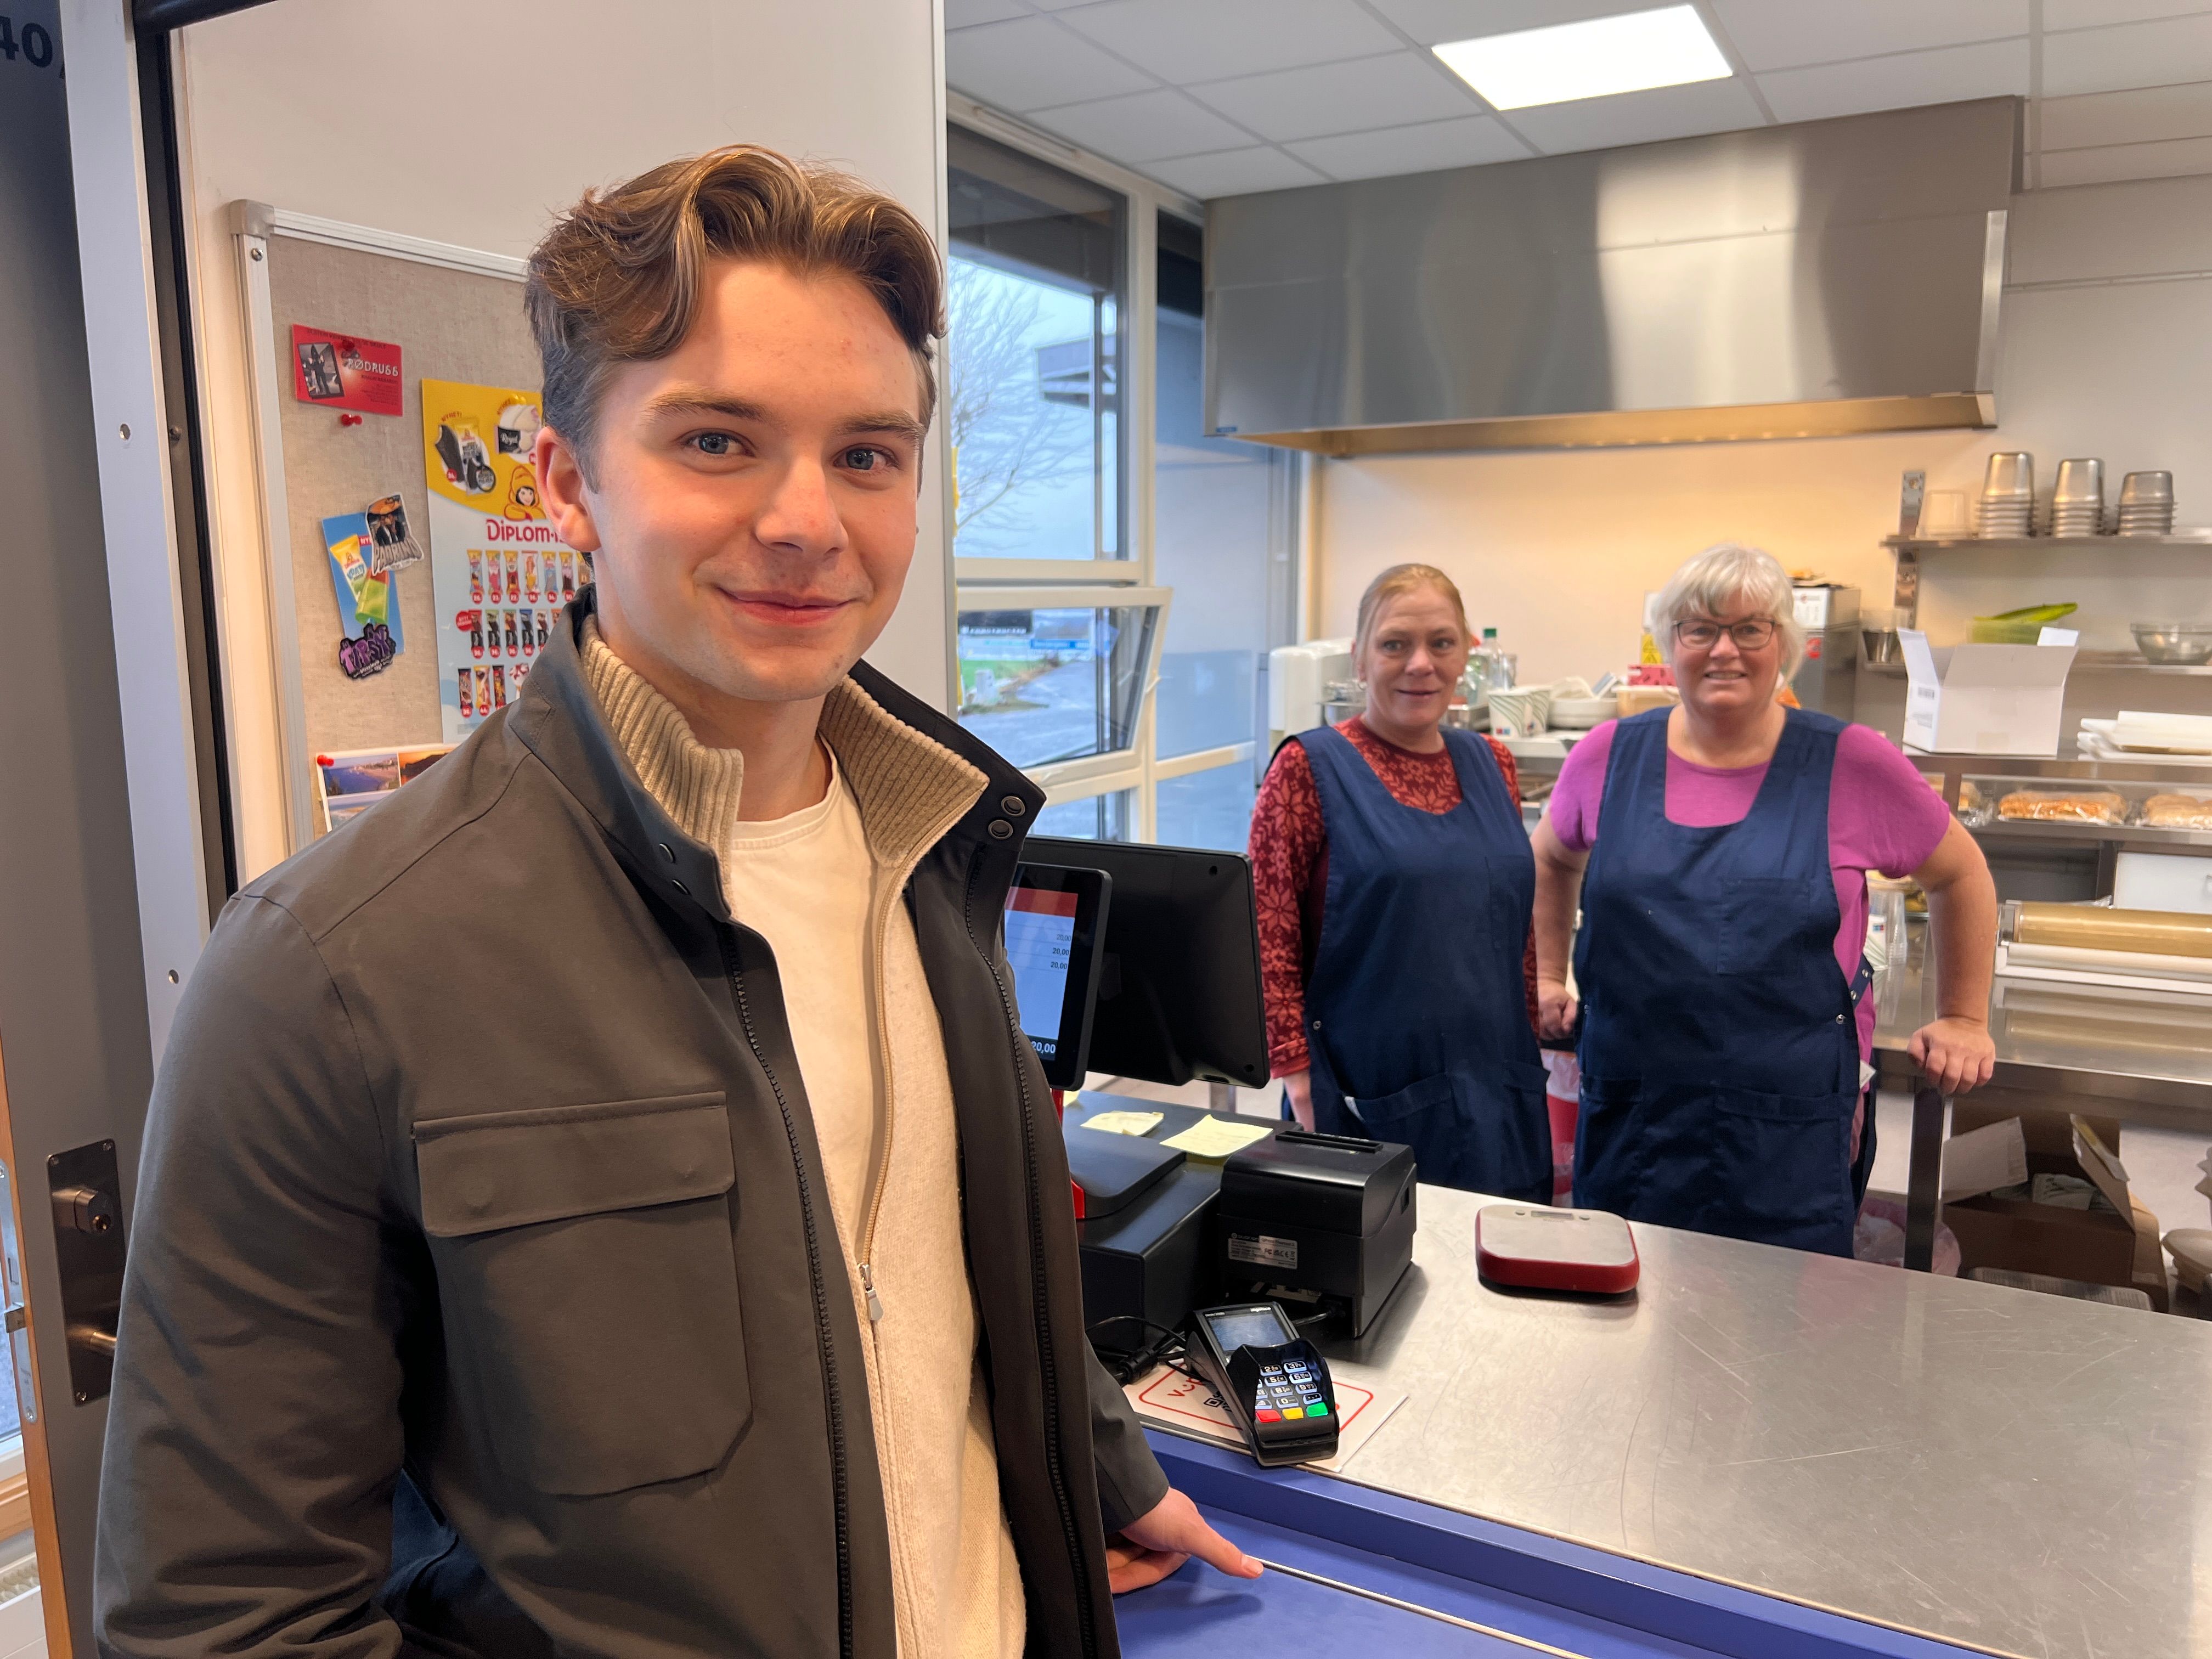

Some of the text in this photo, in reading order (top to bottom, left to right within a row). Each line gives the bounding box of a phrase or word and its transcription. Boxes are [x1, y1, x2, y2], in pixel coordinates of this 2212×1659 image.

[1053, 947, 1069, 956] 20,00
[1050, 961, 1068, 969] 20,00
[1031, 1041, 1056, 1053] 20,00
